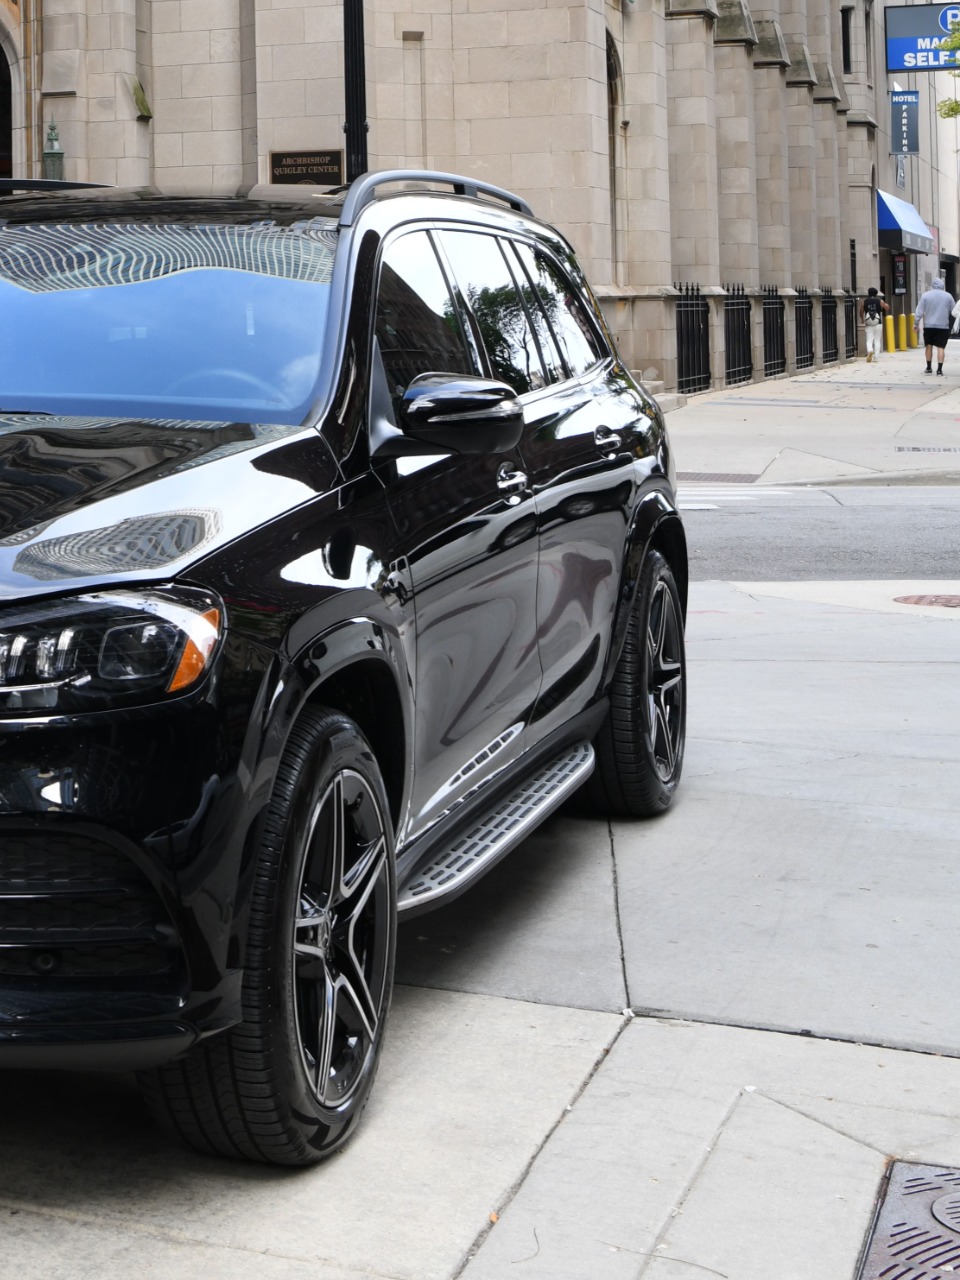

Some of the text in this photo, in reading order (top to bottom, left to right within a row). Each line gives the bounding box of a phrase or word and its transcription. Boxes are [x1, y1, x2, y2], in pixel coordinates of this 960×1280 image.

[903, 51, 950, 67] SELF
[281, 156, 331, 165] ARCHBISHOP
[273, 165, 339, 175] QUIGLEY CENTER
